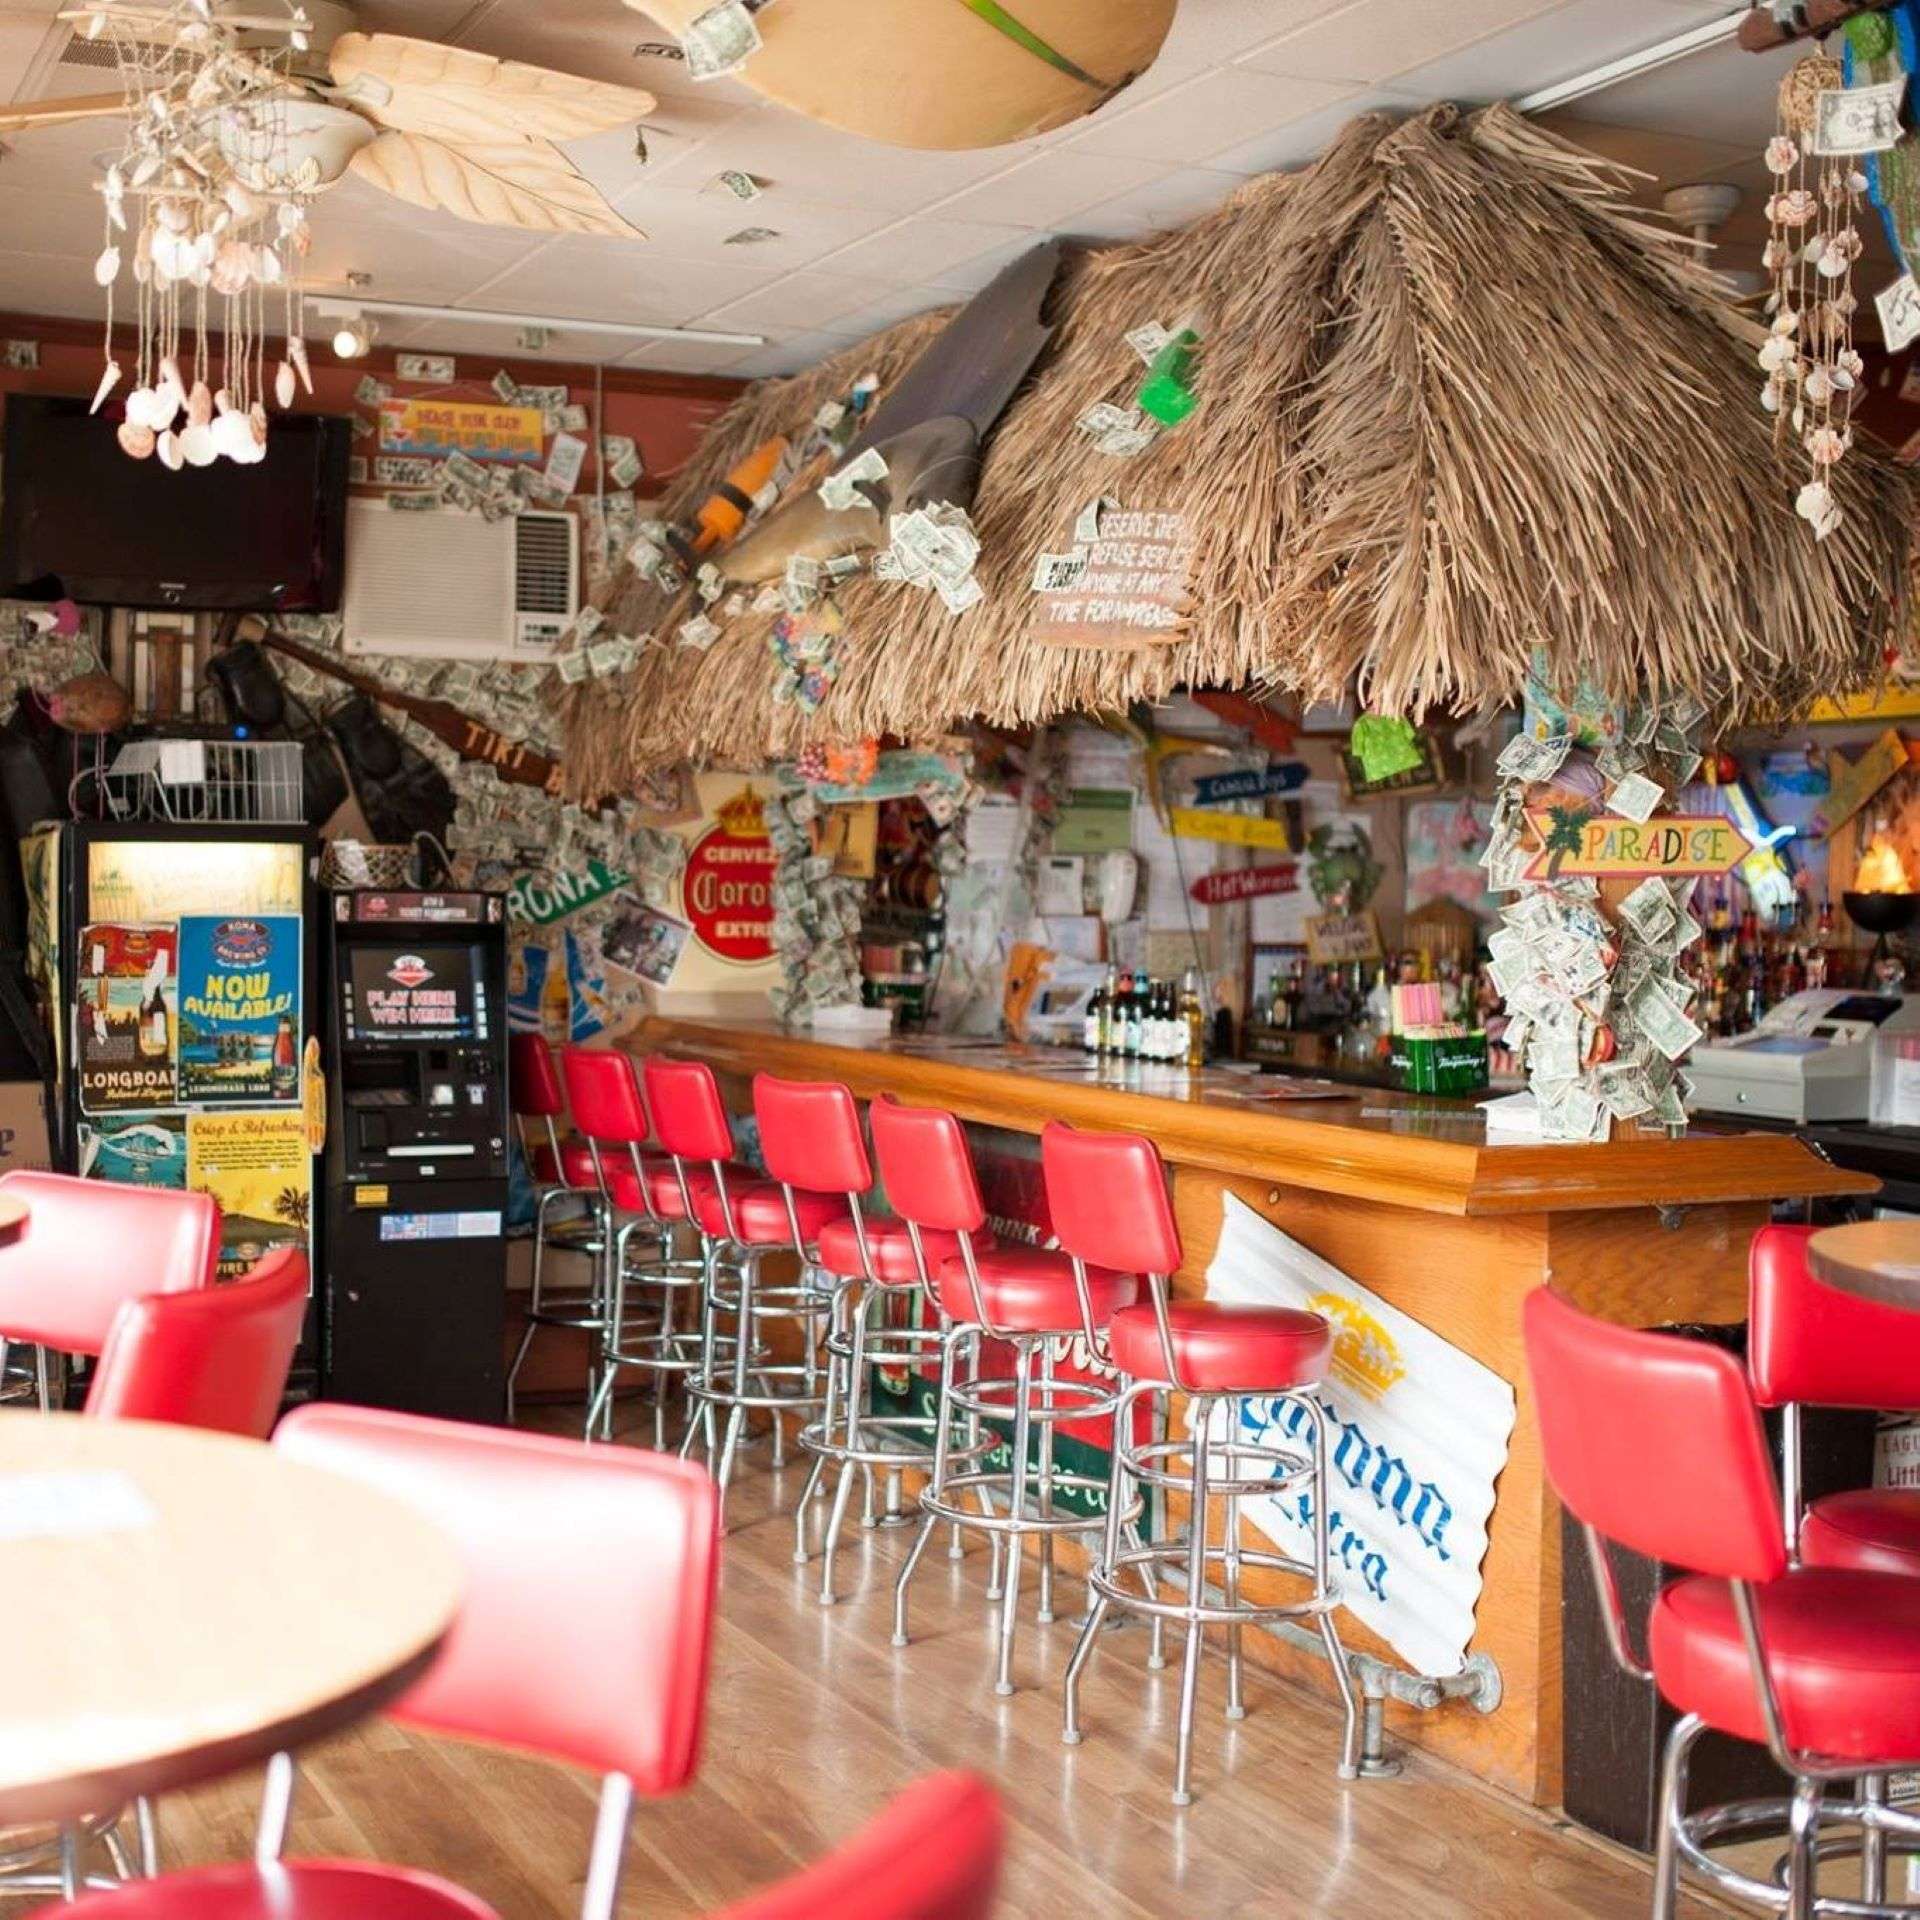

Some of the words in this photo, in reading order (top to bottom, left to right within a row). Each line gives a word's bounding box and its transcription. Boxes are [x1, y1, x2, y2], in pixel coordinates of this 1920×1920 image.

[466, 720, 526, 770] TIKI
[1585, 826, 1729, 865] PARADISE
[693, 871, 775, 914] Coro
[715, 921, 775, 938] EXTR
[205, 972, 270, 1001] NOW
[366, 990, 410, 1006] PLAY
[412, 990, 457, 1006] HERE
[184, 991, 293, 1021] AVAILABLE!
[193, 1121, 226, 1138] Crisp
